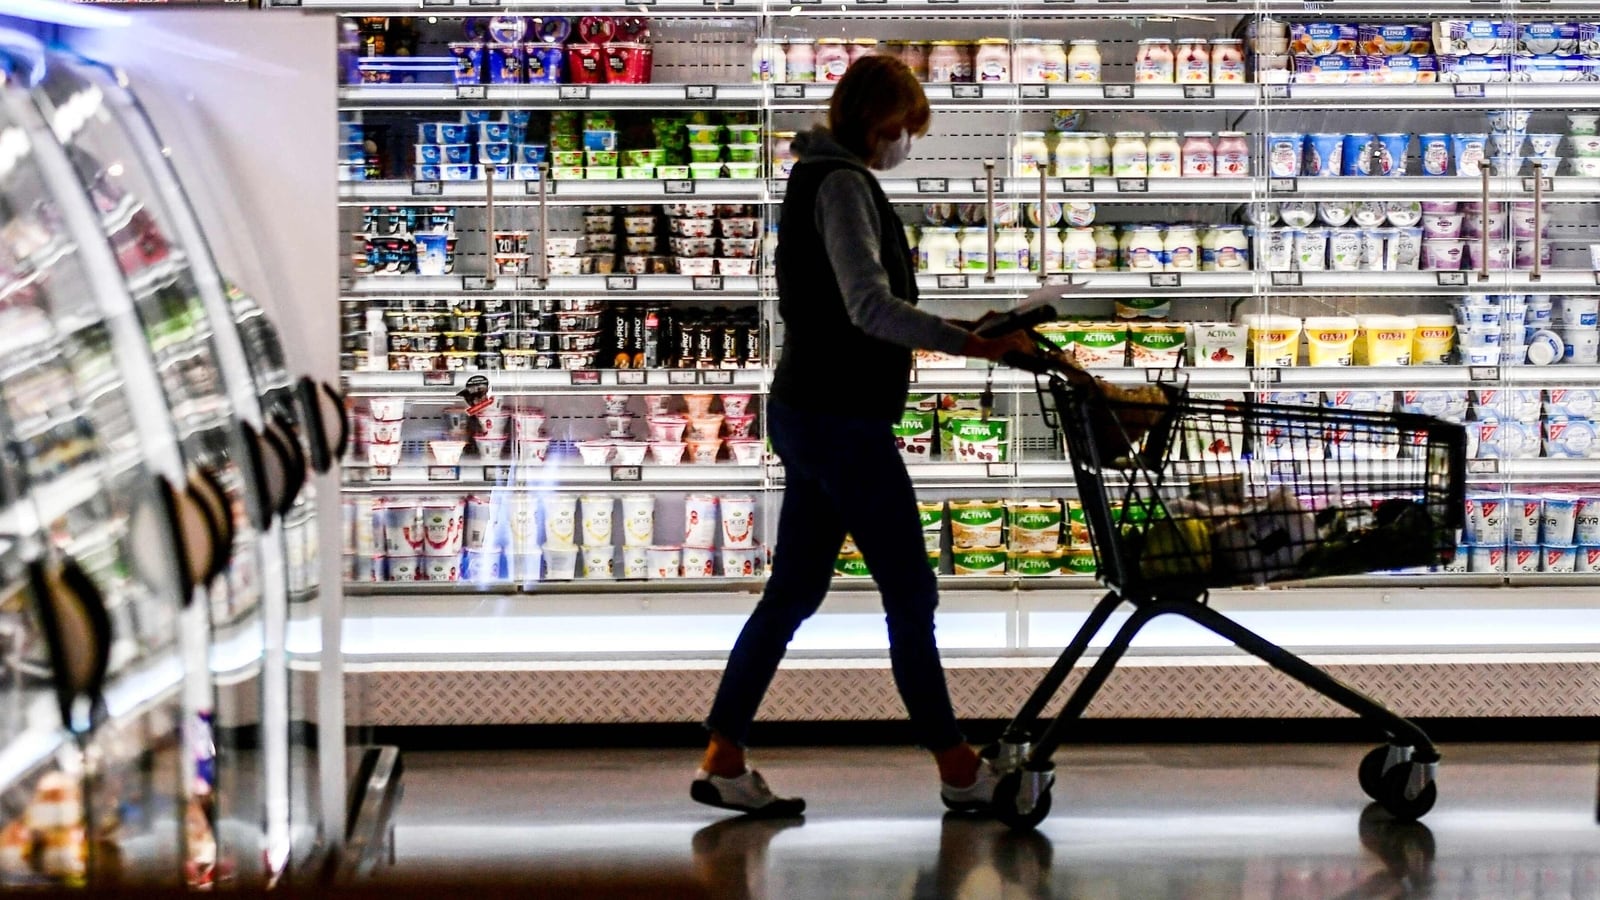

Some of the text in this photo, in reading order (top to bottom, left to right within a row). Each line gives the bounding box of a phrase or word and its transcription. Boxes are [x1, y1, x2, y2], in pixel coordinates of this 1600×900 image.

[498, 239, 511, 252] 20
[616, 317, 624, 349] MyPRO
[634, 317, 642, 349] MyPRO
[1083, 333, 1116, 342] ACTIVIA
[1207, 330, 1236, 338] ACTIVIA
[1321, 333, 1347, 341] GAZI
[1379, 333, 1406, 341] GAZI
[1422, 330, 1449, 338] GAZI
[1142, 334, 1174, 343] ACTIVIA
[960, 426, 991, 435] ACTIVIA
[960, 511, 992, 520] ACTIVIA
[1018, 515, 1050, 523] ACTIVIA
[1577, 518, 1599, 526] SKYR
[963, 555, 996, 563] ACTIVIA
[1018, 560, 1050, 569] ACTIVIA
